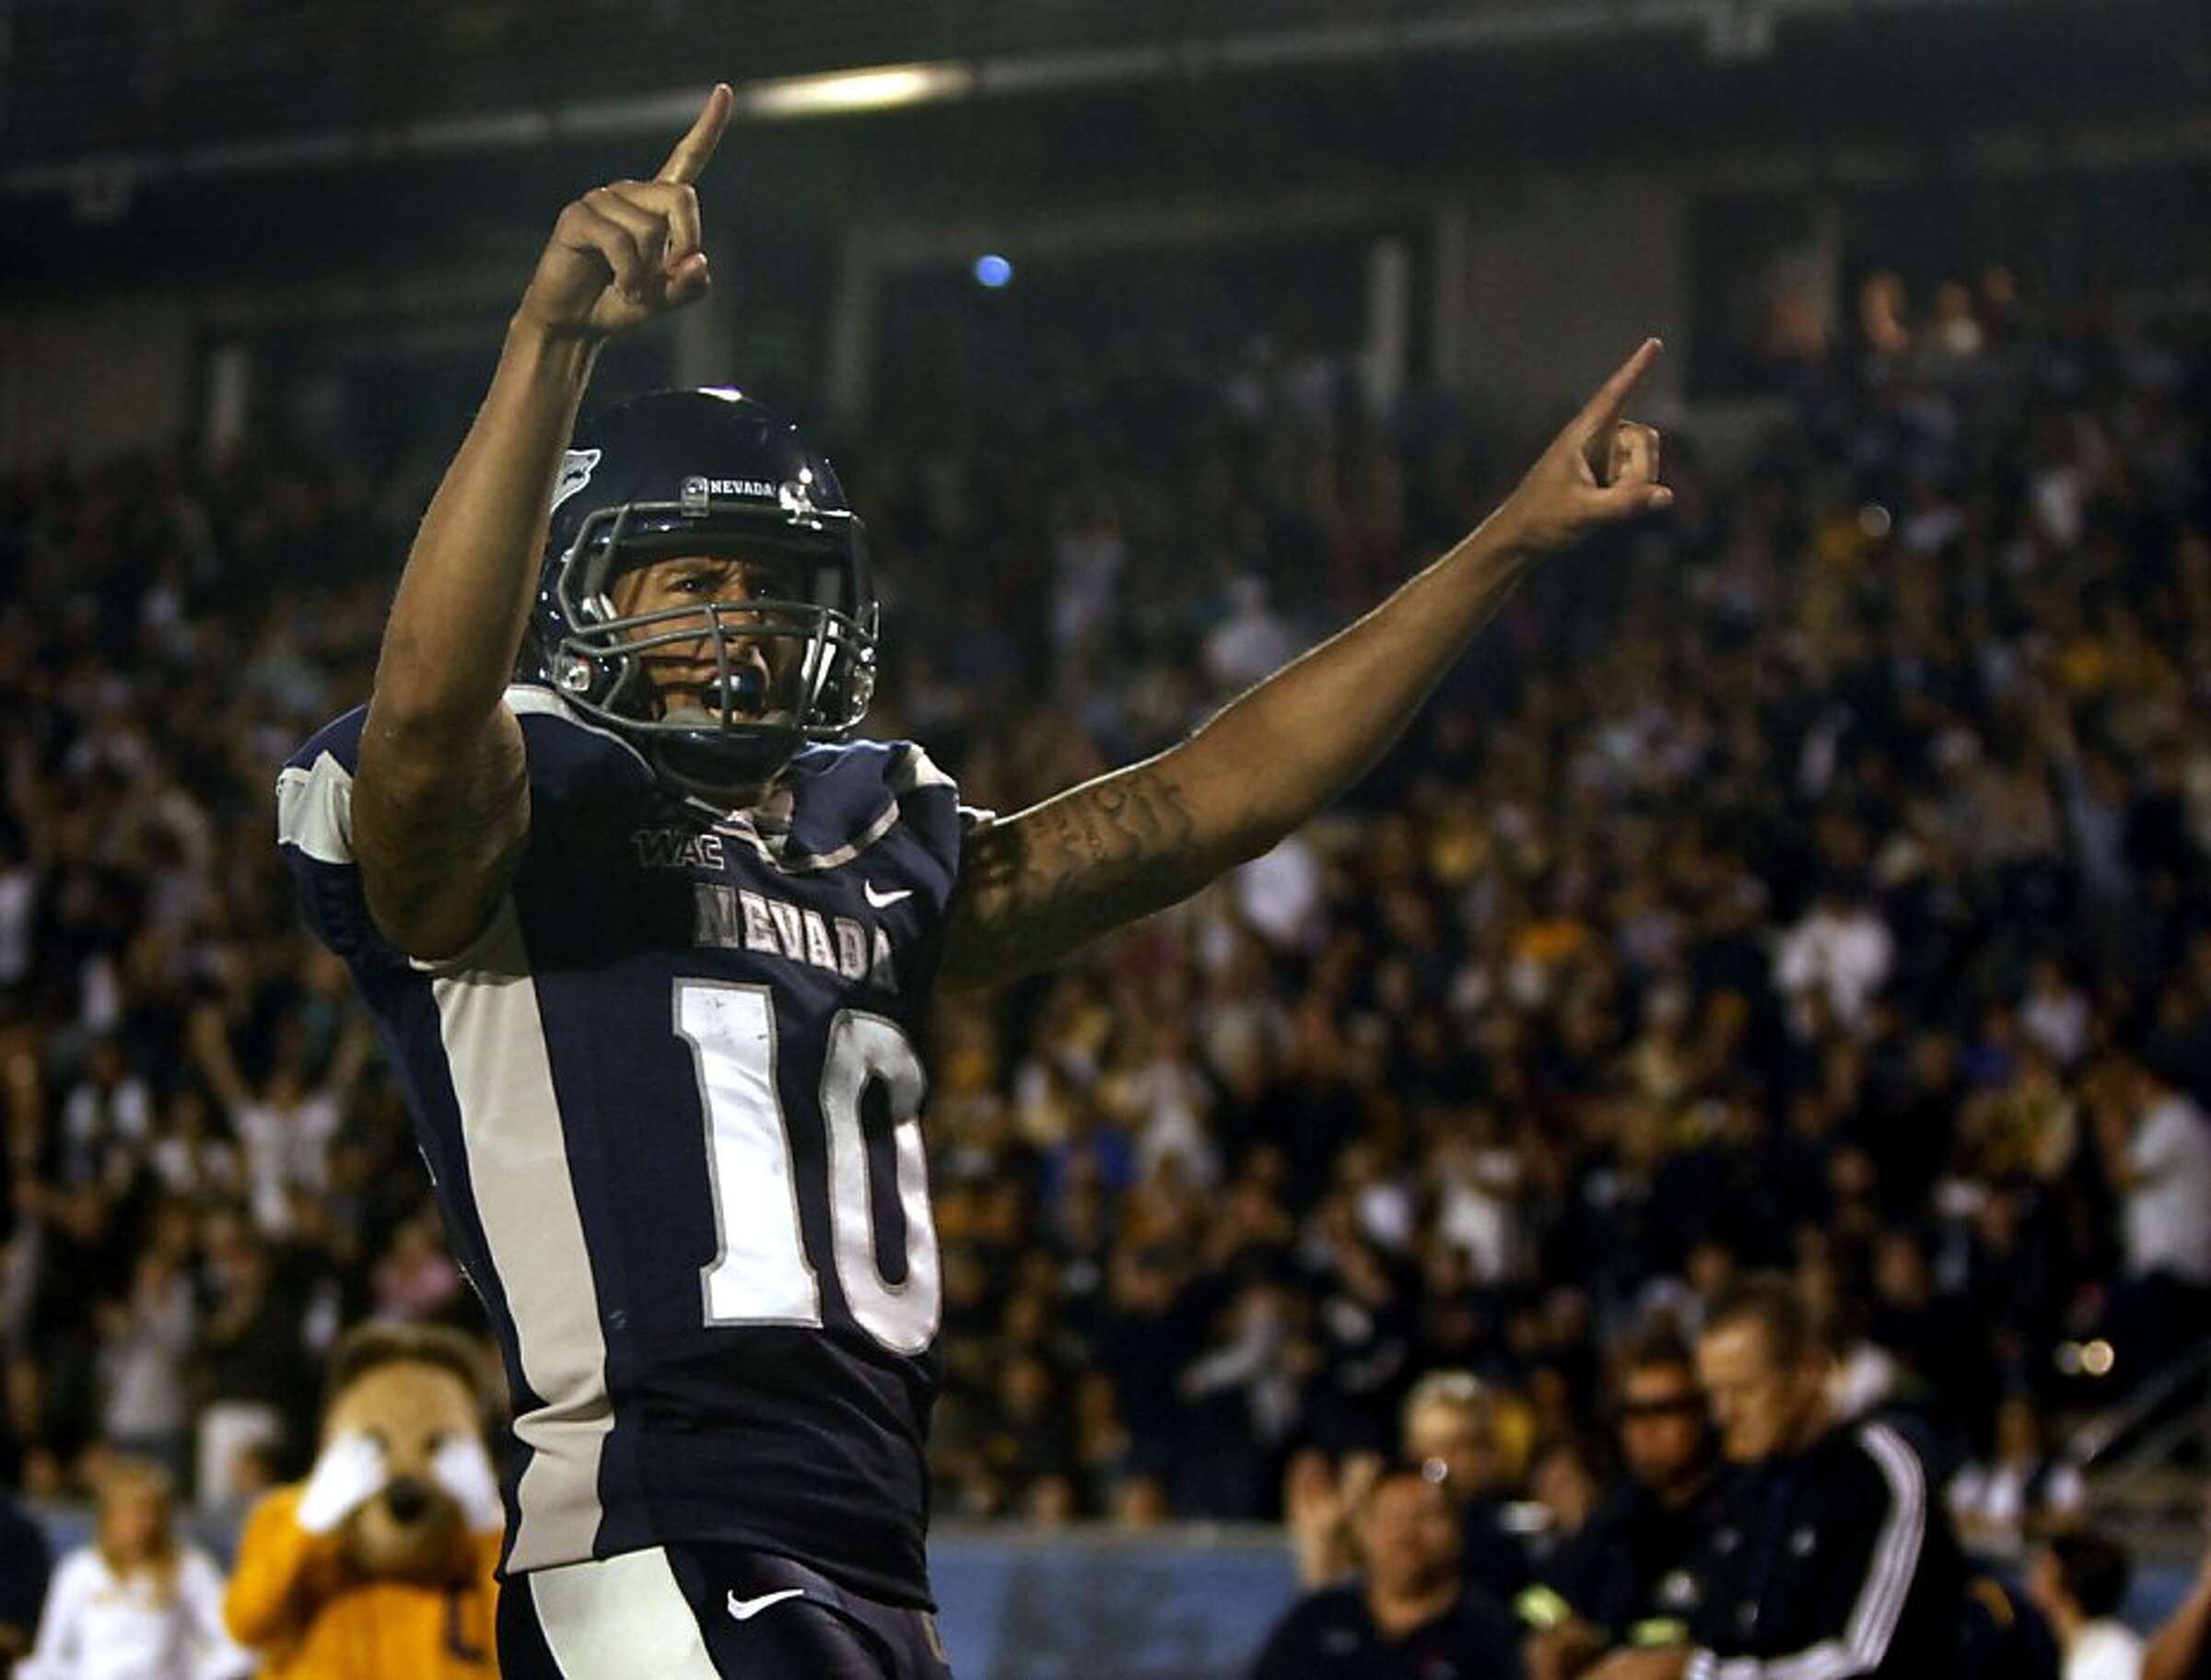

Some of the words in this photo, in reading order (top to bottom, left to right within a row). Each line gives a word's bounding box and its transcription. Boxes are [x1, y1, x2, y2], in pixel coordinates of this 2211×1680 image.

[710, 479, 777, 498] NEVADA
[630, 829, 725, 870] WAC
[673, 976, 942, 1355] 10
